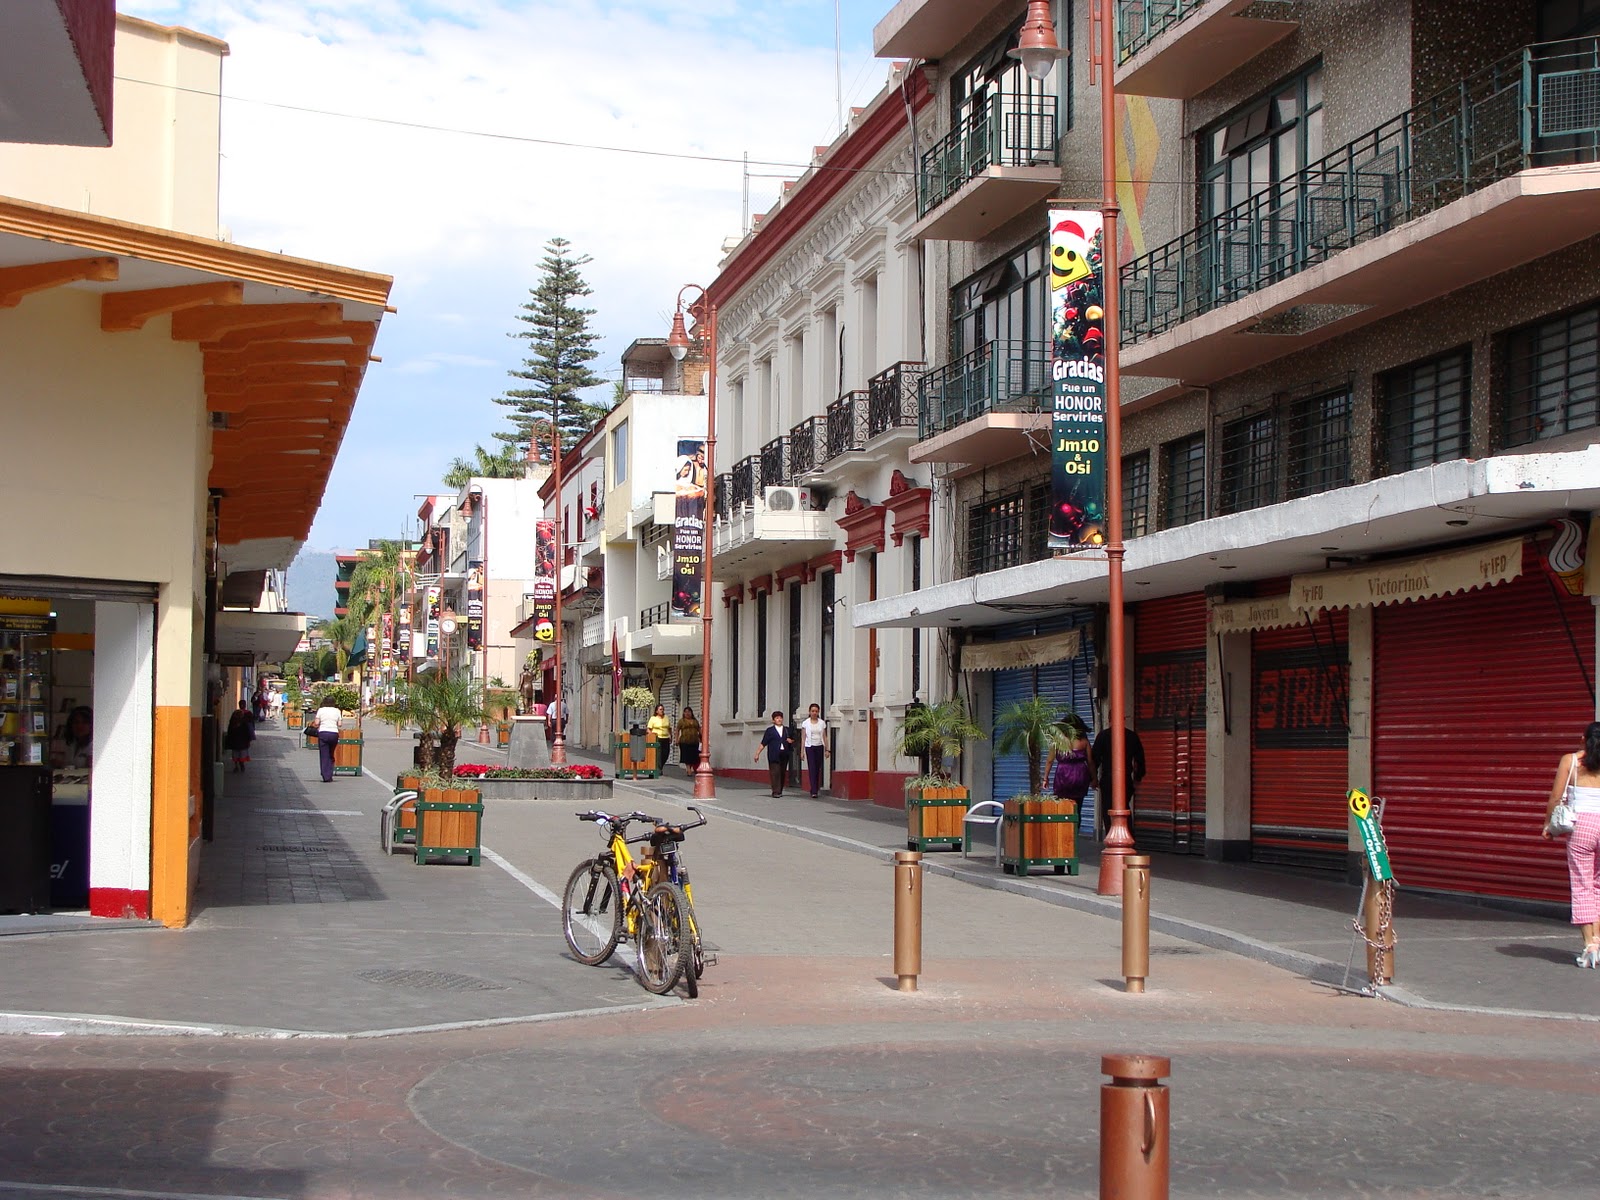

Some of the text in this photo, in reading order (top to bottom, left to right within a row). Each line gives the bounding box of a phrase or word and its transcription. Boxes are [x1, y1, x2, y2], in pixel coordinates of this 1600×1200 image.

[1053, 356, 1104, 384] Gracias
[1062, 384, 1096, 393] Fue un
[1055, 396, 1102, 411] HONOR
[1053, 412, 1103, 423] Servirles
[1057, 439, 1099, 452] Jm10
[1074, 454, 1082, 462] &
[1065, 460, 1091, 475] Osi
[675, 515, 703, 529] Gracias
[676, 535, 702, 544] HONOR
[681, 567, 695, 575] Osi
[1368, 574, 1430, 596] Victorinox
